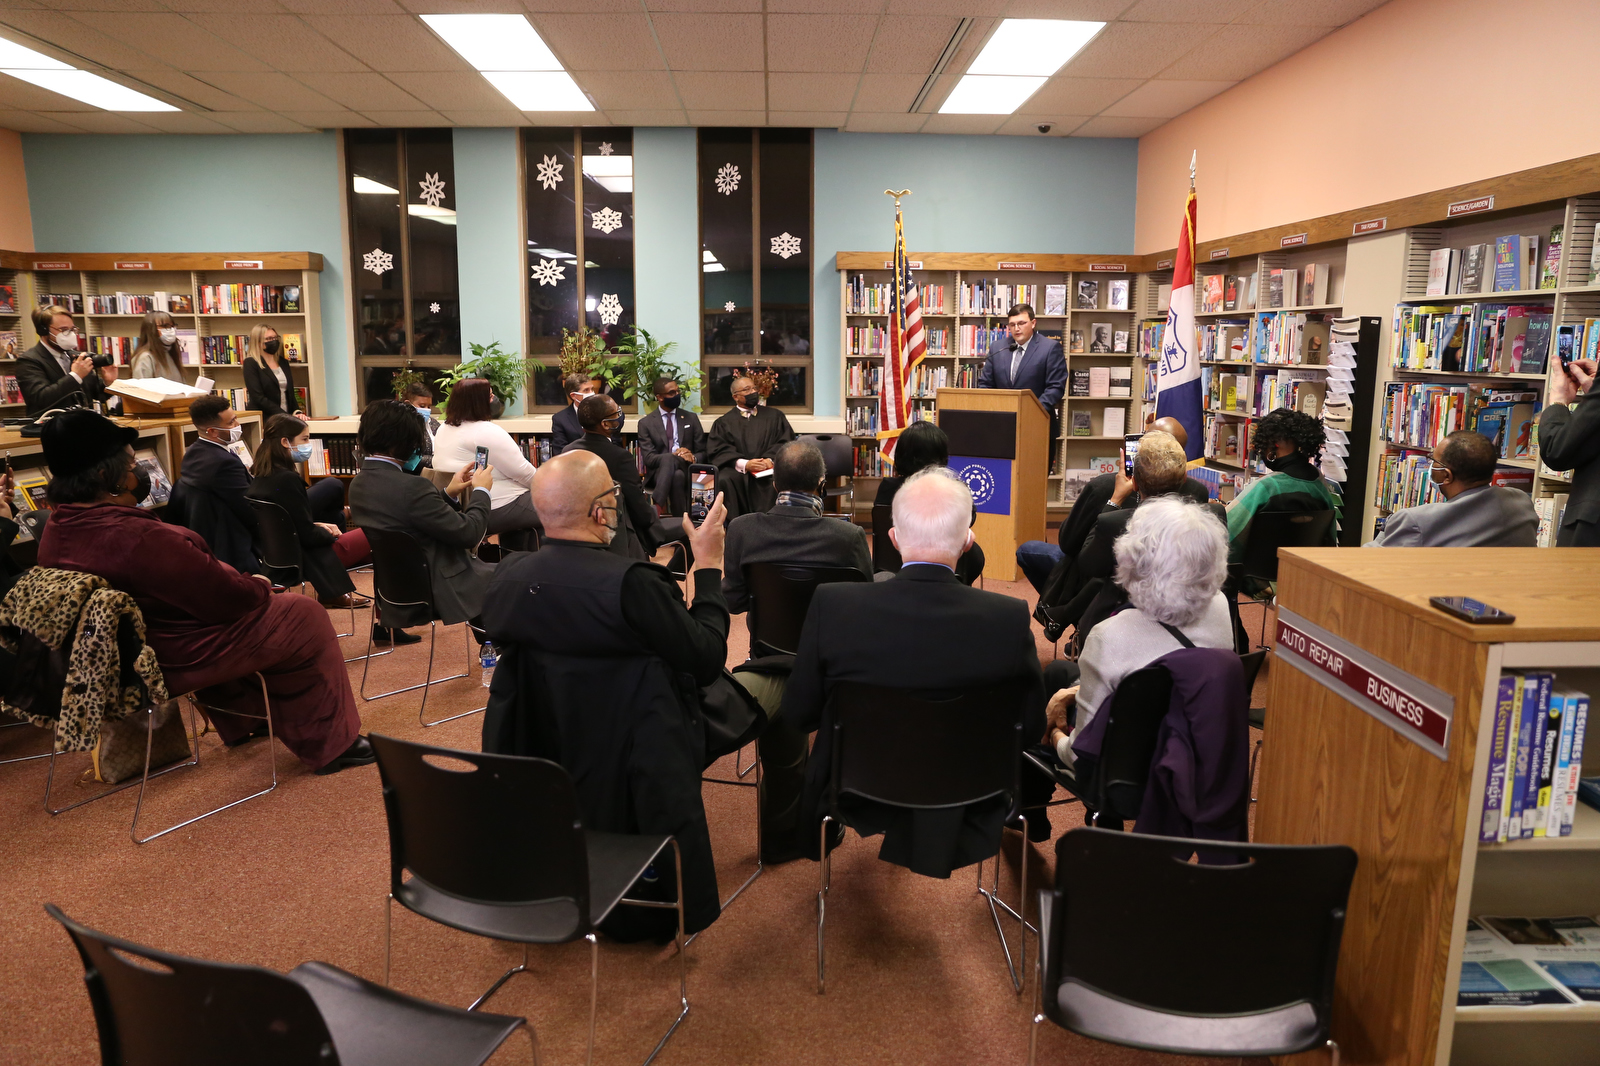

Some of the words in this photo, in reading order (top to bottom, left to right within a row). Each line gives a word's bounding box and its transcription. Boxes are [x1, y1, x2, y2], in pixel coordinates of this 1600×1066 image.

[1452, 200, 1489, 213] SCIENCE/GARDEN
[1497, 242, 1514, 254] SELF-
[1497, 253, 1514, 264] CARE
[1529, 319, 1541, 330] how
[1542, 321, 1549, 330] to
[985, 469, 995, 487] LIBRARY
[1100, 464, 1114, 473] 50
[1281, 627, 1306, 653] AUTO
[1308, 642, 1344, 676] REPAIR
[1366, 676, 1425, 727] BUSINESS
[1539, 678, 1550, 710] Federal
[1494, 700, 1512, 759] Résumé
[1534, 711, 1545, 744] Resume
[1573, 703, 1588, 759] RESUMES
[1516, 746, 1529, 776] POP!
[1529, 747, 1542, 793] Guidebook
[1541, 730, 1557, 780] Resumes
[1487, 763, 1505, 807] Magic
[1554, 770, 1567, 812] RESUMES
